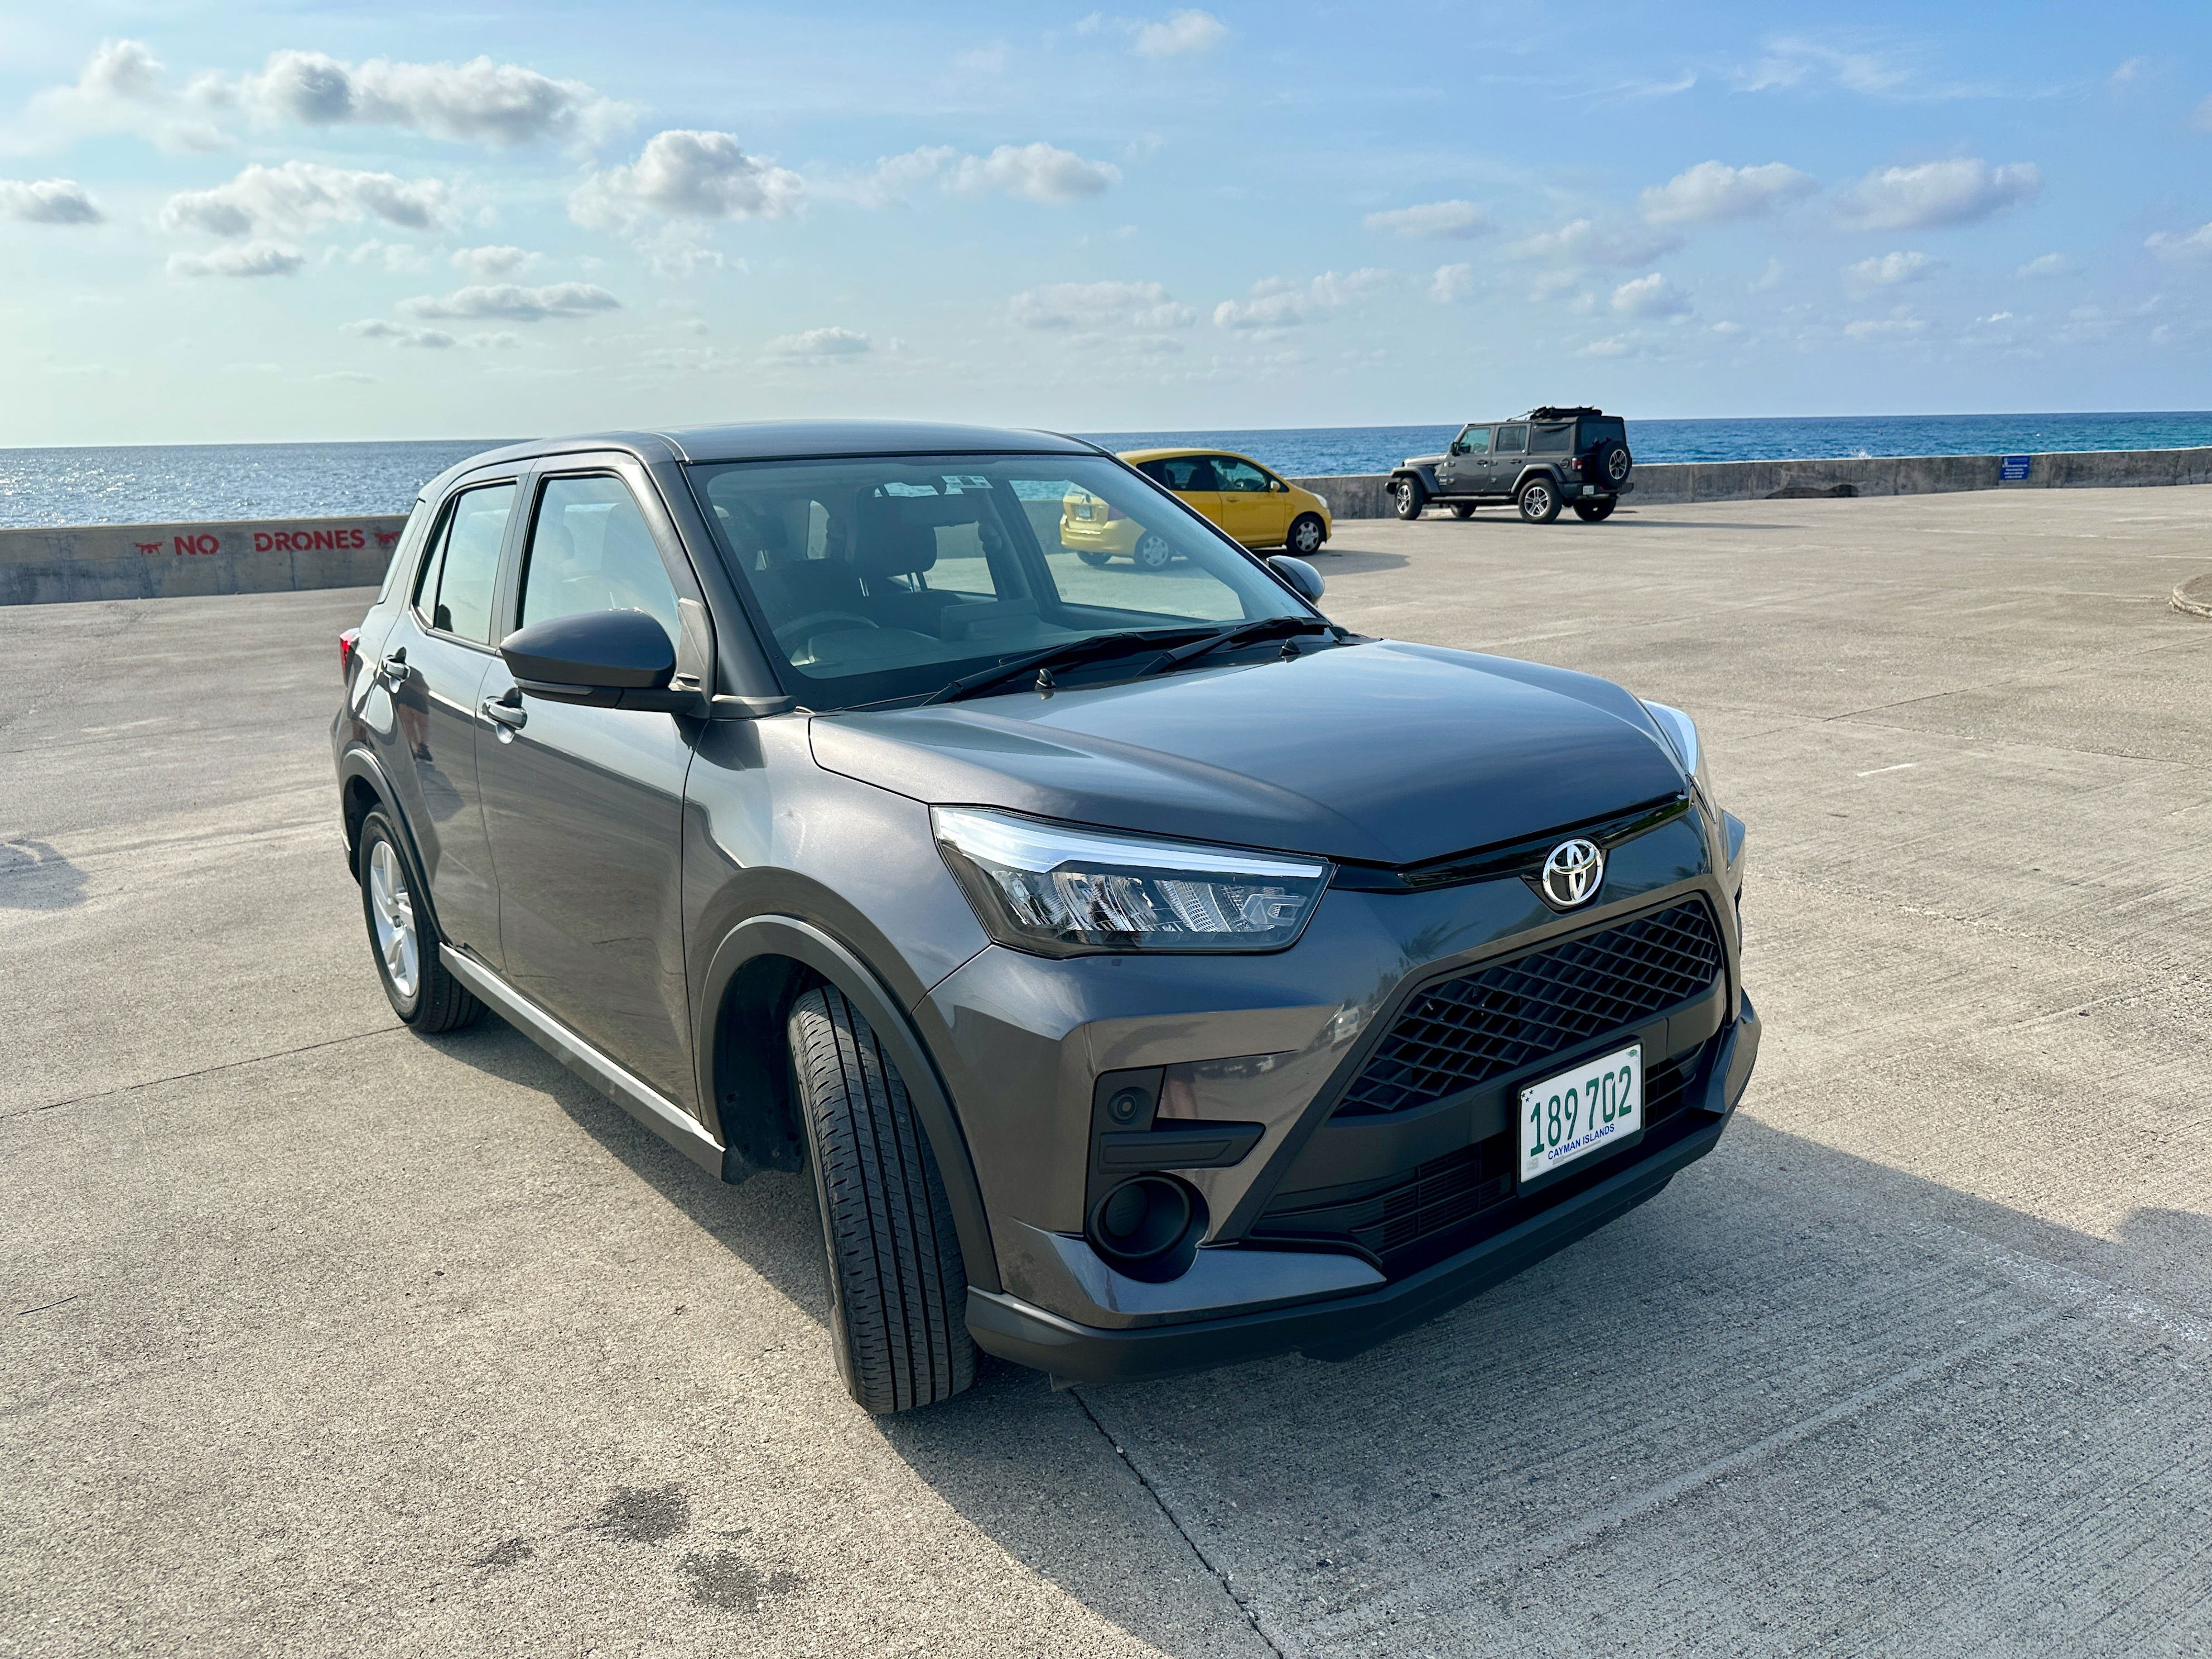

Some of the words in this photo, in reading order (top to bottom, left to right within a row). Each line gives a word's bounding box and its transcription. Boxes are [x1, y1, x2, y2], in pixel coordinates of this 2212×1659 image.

[174, 534, 219, 556] NO
[254, 529, 365, 552] DRONES
[1530, 1088, 1578, 1157] 189
[1585, 1065, 1632, 1131] 702
[1548, 1139, 1580, 1160] CAYMAN
[1583, 1123, 1615, 1145] ISLANDS
